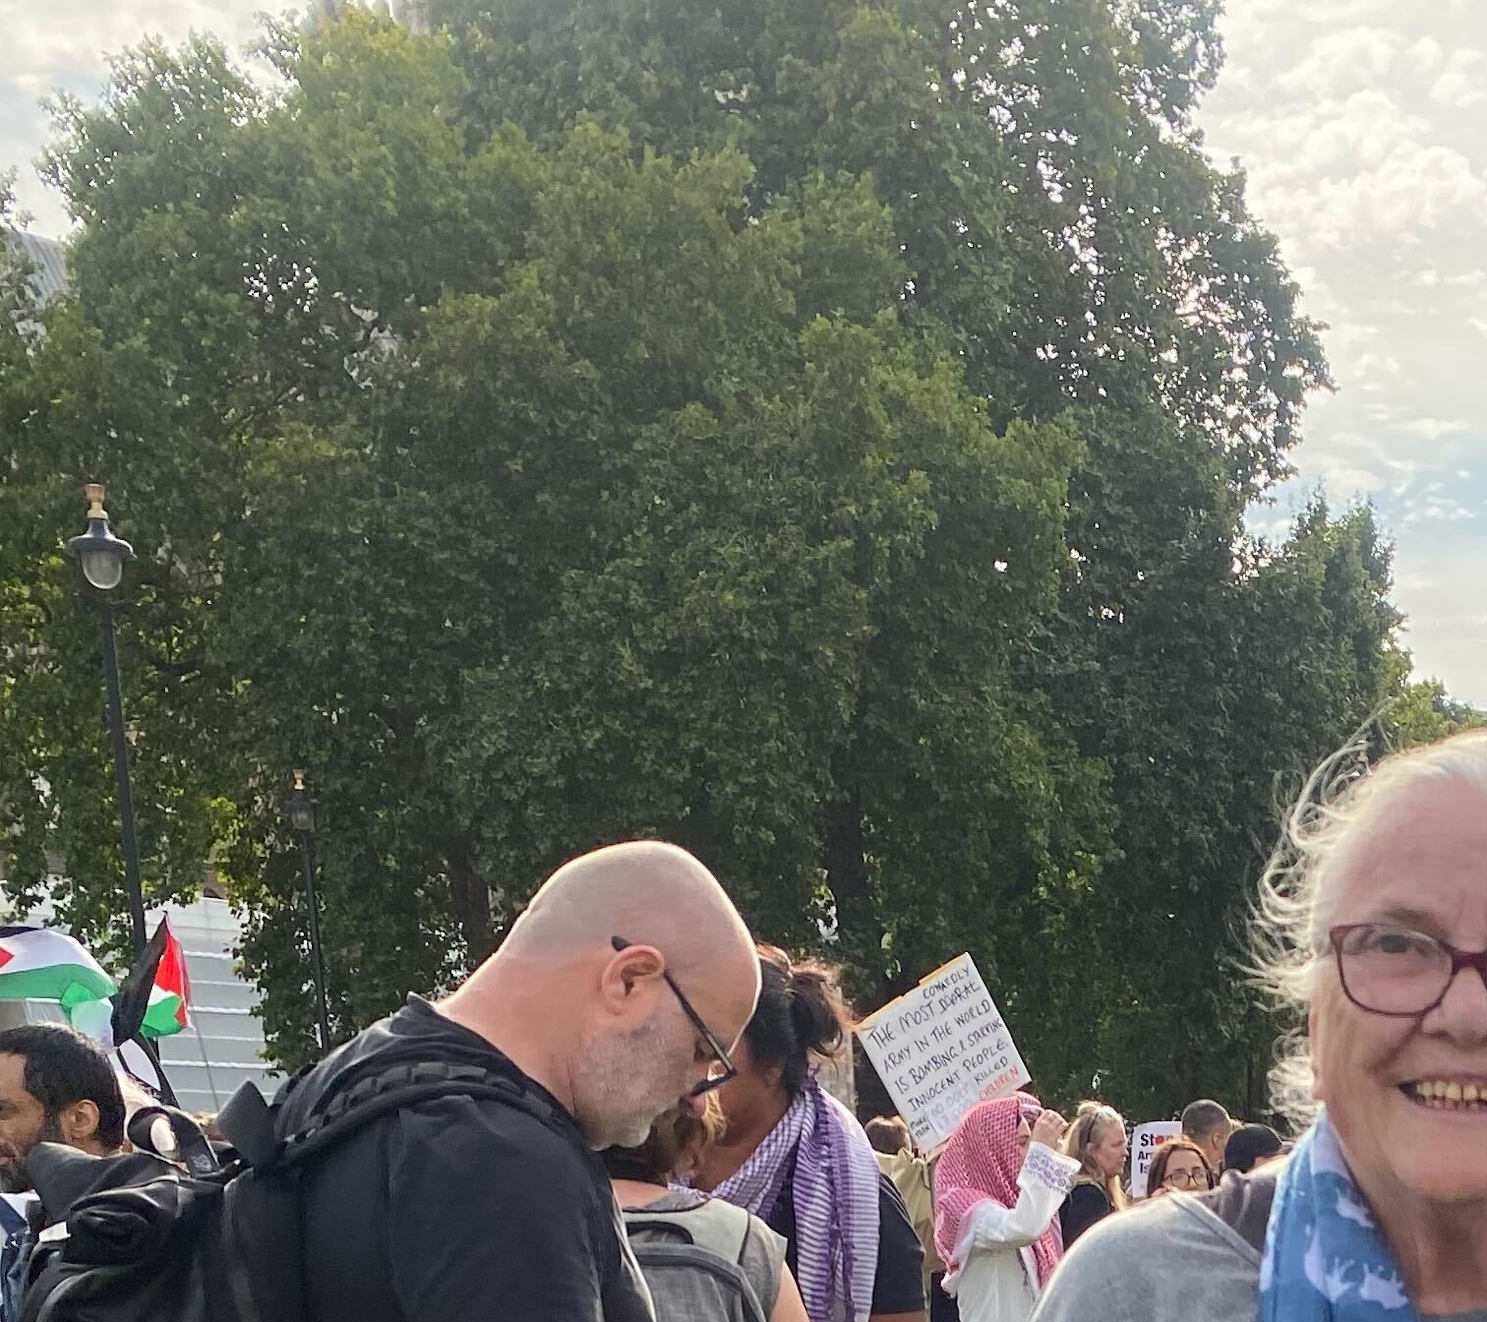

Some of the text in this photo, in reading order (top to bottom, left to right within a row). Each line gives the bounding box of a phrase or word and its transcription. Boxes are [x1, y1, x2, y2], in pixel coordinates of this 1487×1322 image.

[867, 1021, 897, 1049] THE
[900, 1002, 939, 1032] MOST
[883, 999, 992, 1073] ARMY IN THE WORLD
[894, 1077, 910, 1095] IS
[909, 1046, 959, 1085] BOMBING
[906, 1071, 962, 1112] INNOCENT
[974, 1055, 1009, 1086] KILLED
